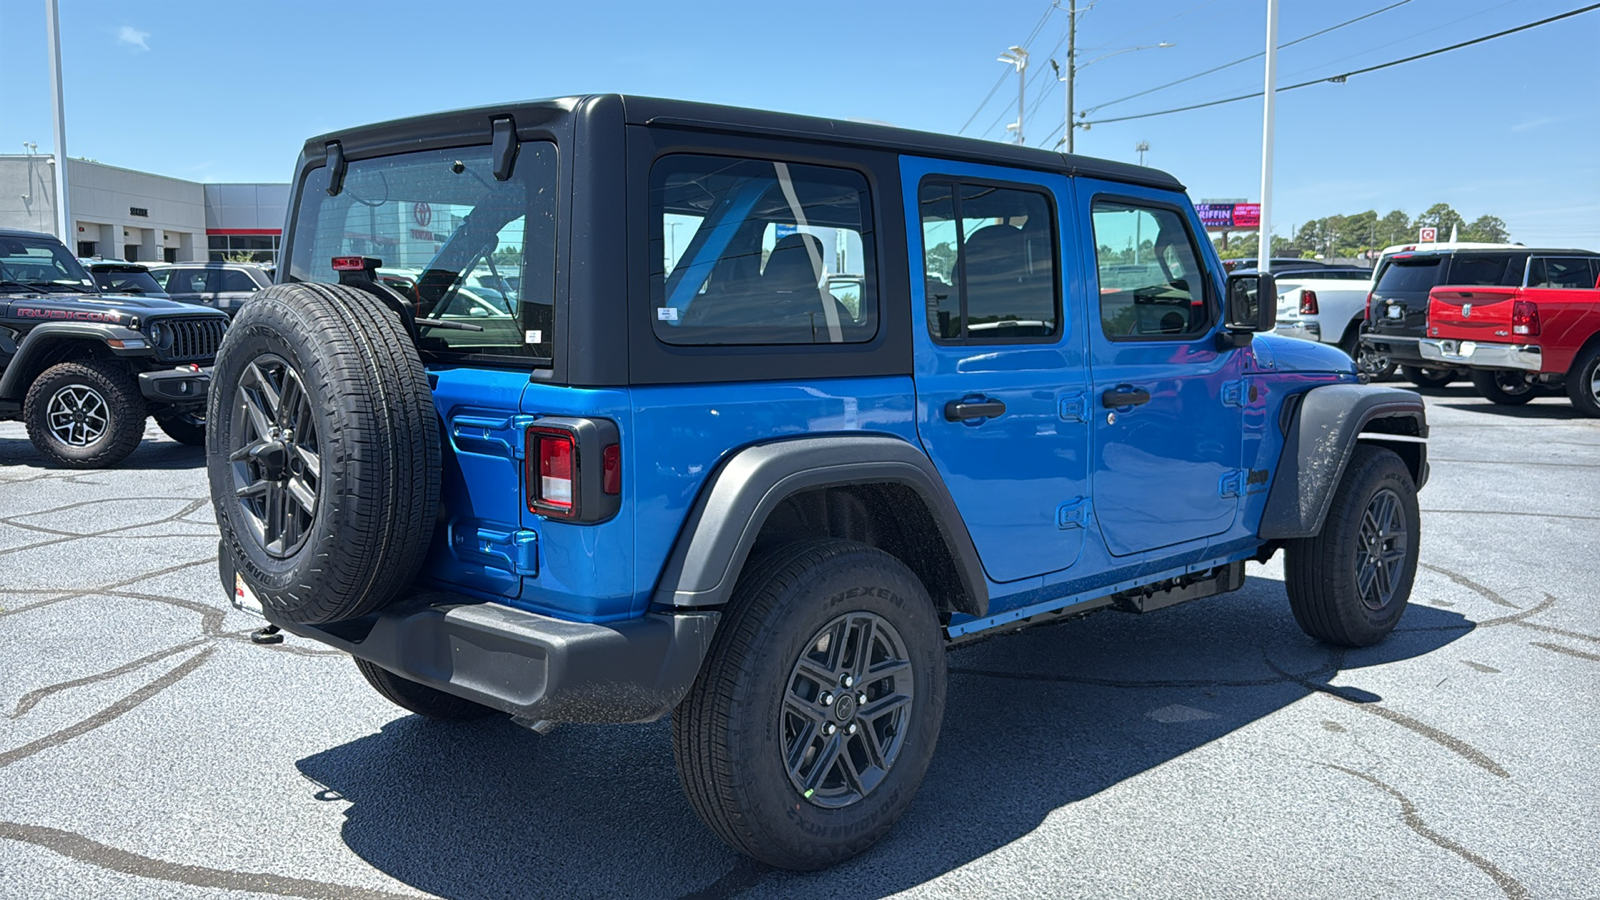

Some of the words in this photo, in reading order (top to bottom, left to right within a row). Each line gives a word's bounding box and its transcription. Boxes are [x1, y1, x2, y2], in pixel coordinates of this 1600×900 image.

[1197, 210, 1231, 219] RIFFIN
[17, 308, 121, 323] RUBICON
[830, 587, 904, 609] NEXEN
